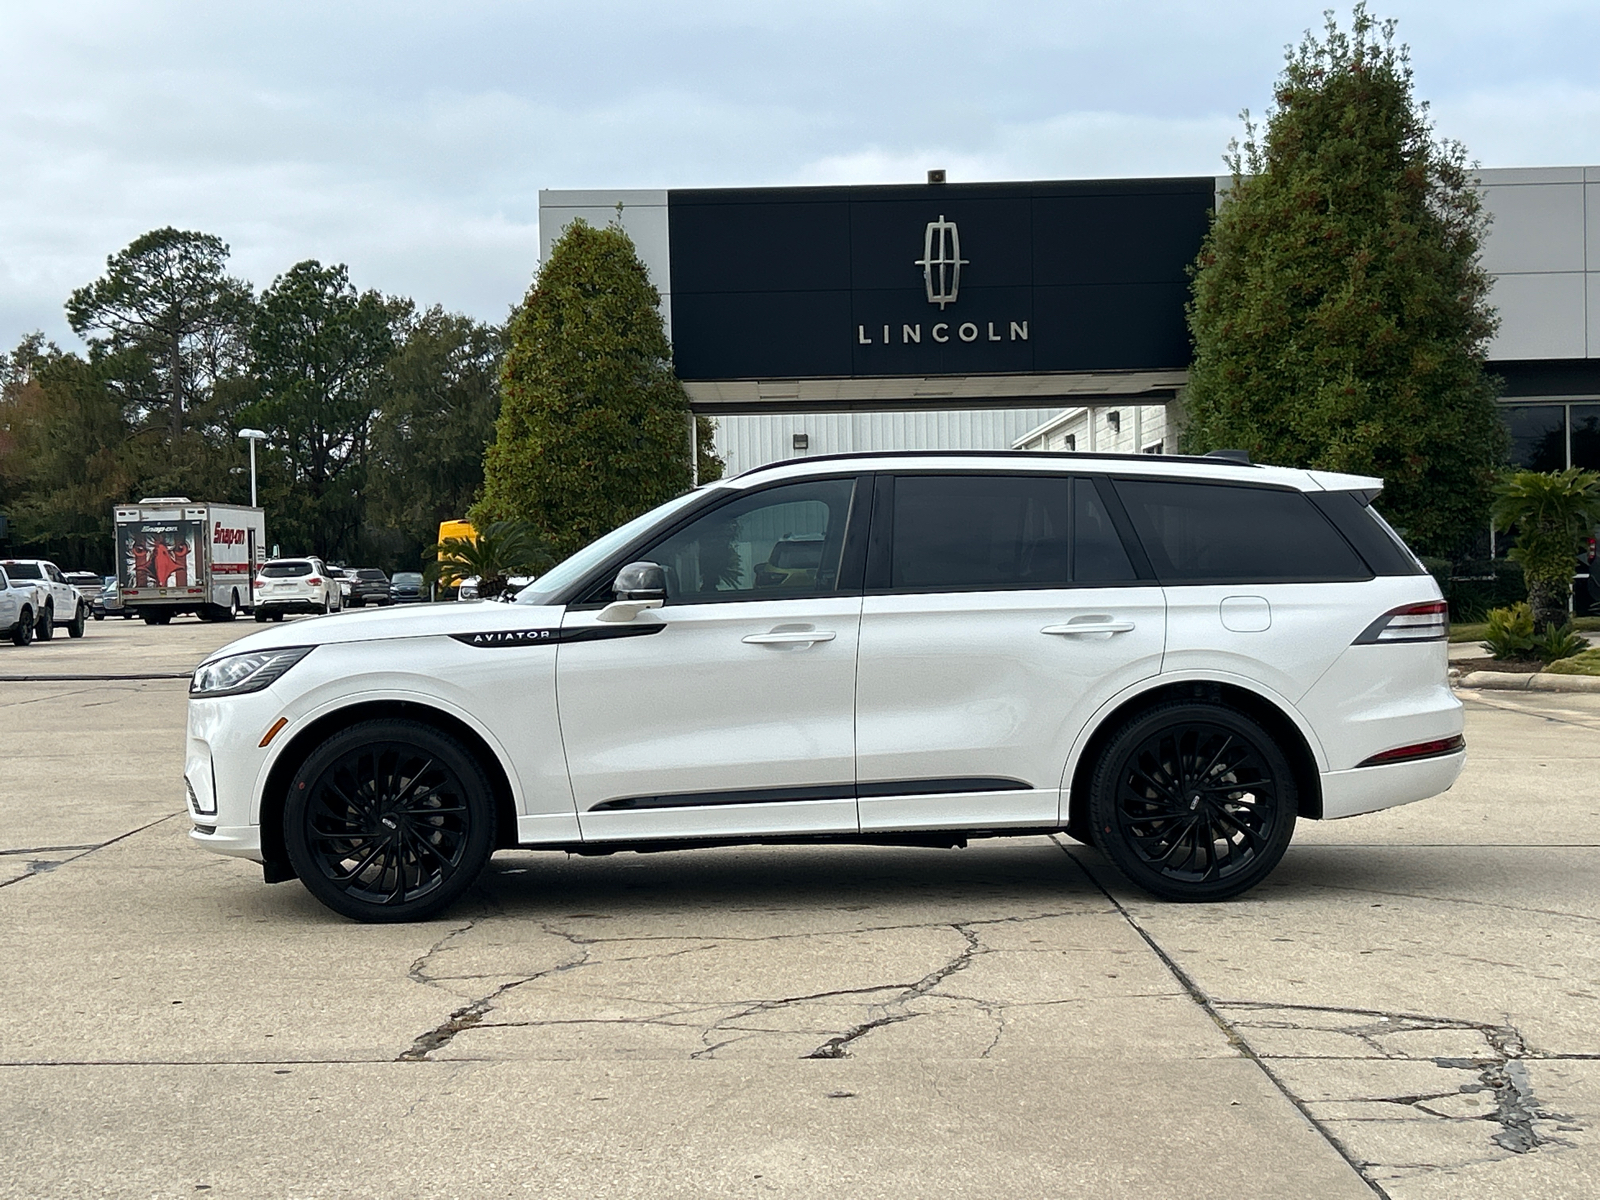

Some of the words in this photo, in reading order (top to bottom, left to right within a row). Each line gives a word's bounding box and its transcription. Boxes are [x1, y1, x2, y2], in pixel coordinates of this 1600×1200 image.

[858, 321, 1029, 344] LINCOLN
[141, 525, 178, 533] Snap-on
[213, 521, 245, 549] Snap-on
[473, 631, 550, 643] AVIATOR
